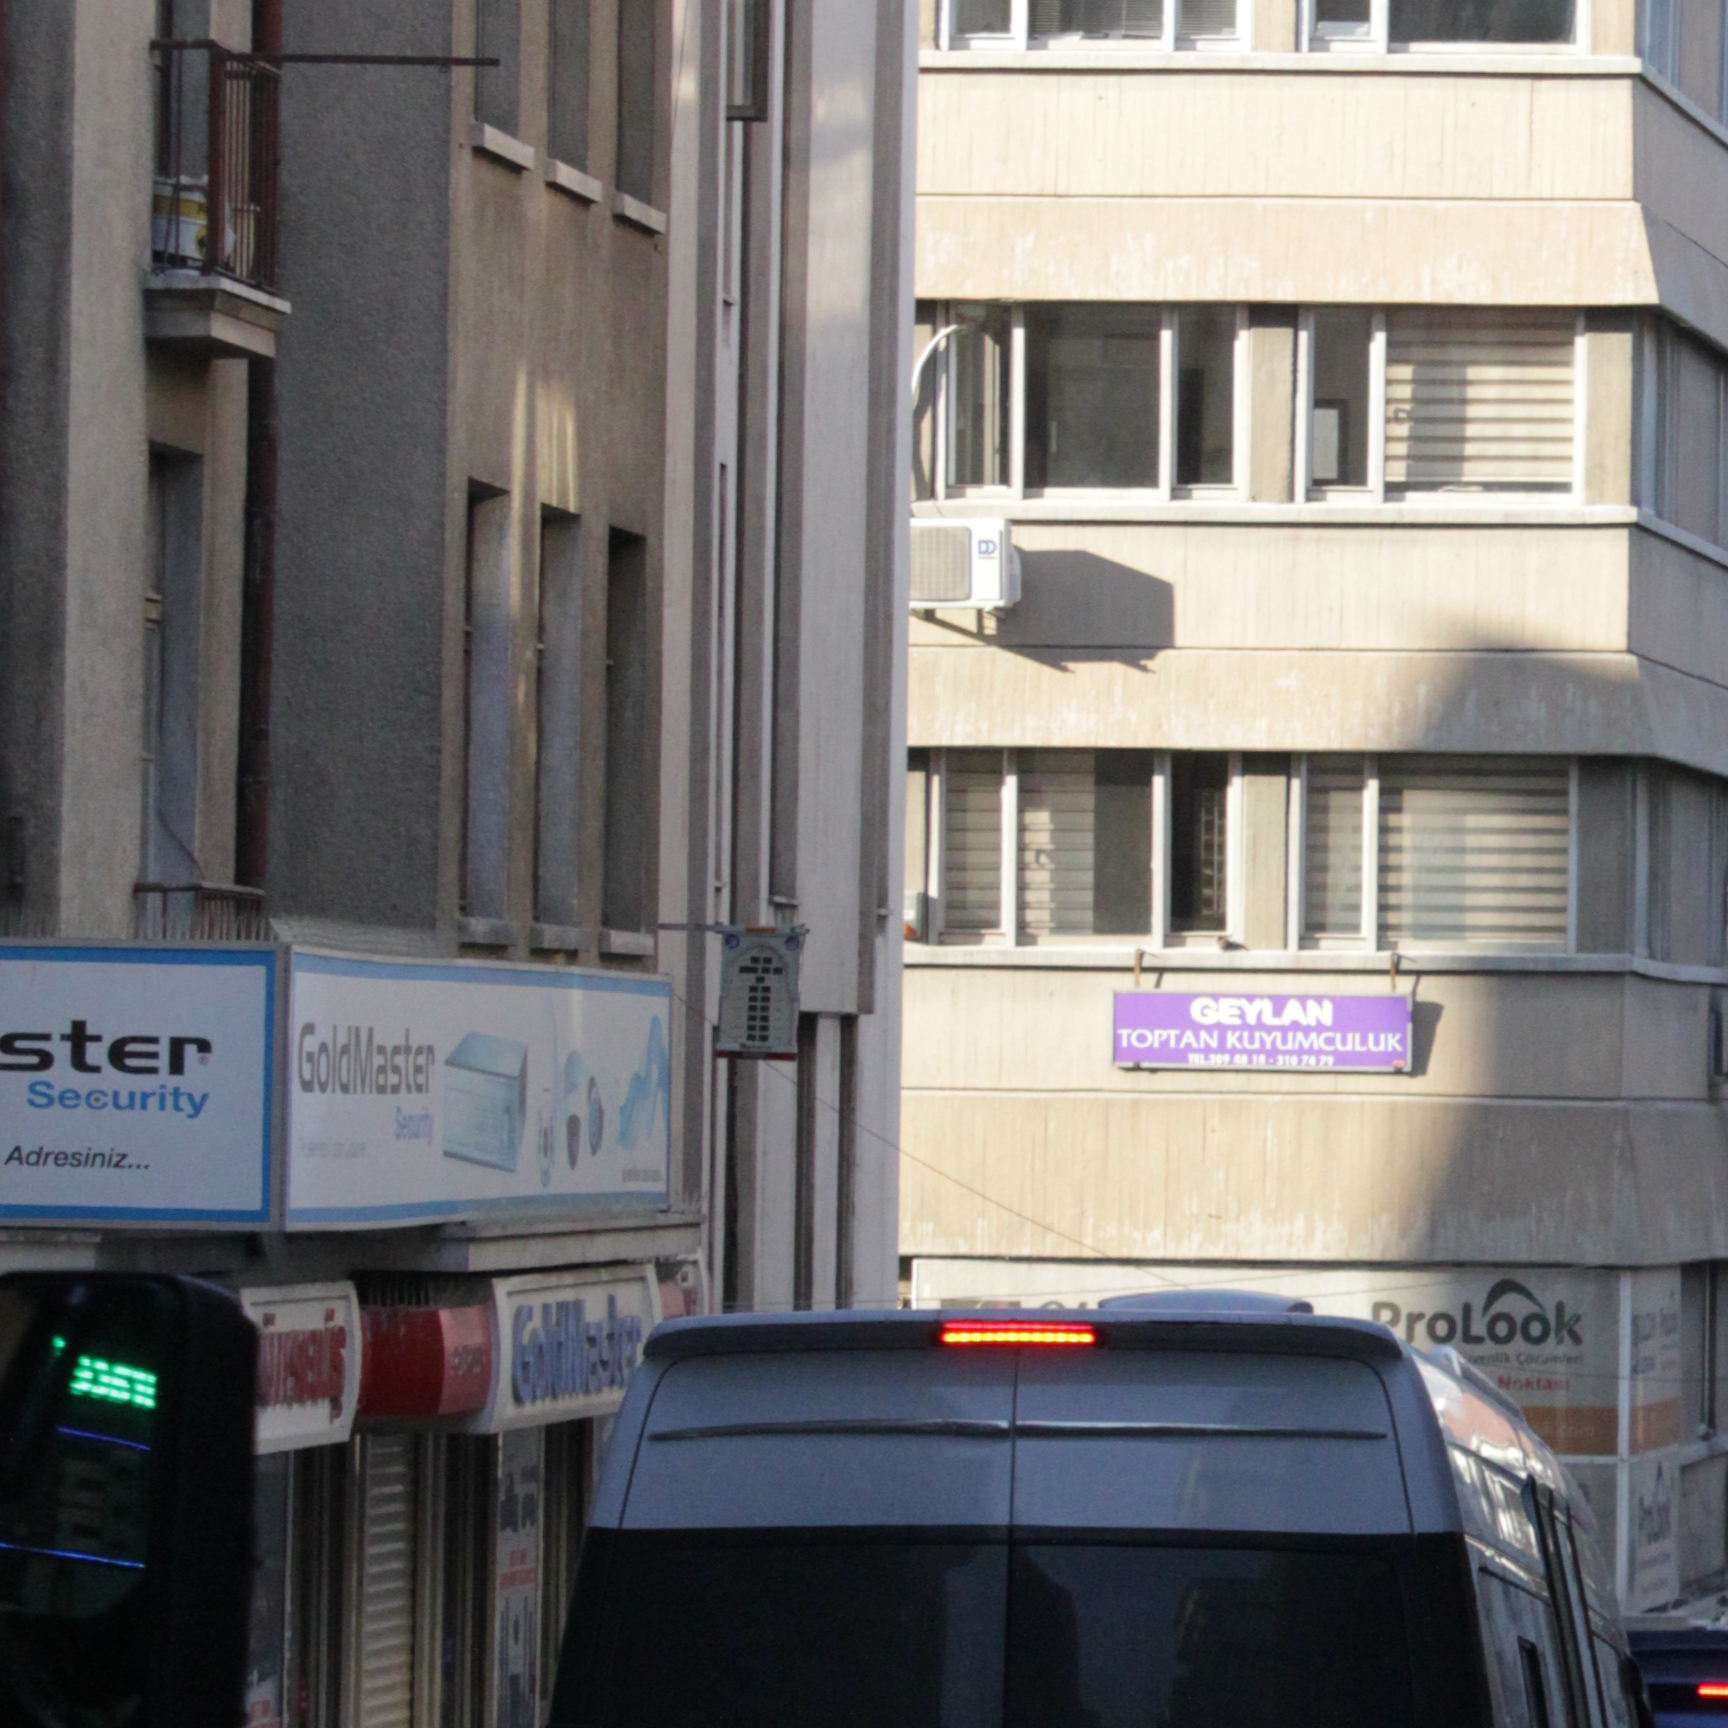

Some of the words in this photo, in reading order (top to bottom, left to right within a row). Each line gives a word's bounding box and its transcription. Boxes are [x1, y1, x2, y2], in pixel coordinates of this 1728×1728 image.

[299, 1023, 435, 1096] GoldMaster
[1117, 1028, 1219, 1050] TOPTAN
[1225, 1029, 1403, 1052] KUYUMCULUK
[27, 1079, 210, 1120] Security
[4, 1144, 150, 1170] Adresiniz...
[1372, 1300, 1584, 1347] ProLook
